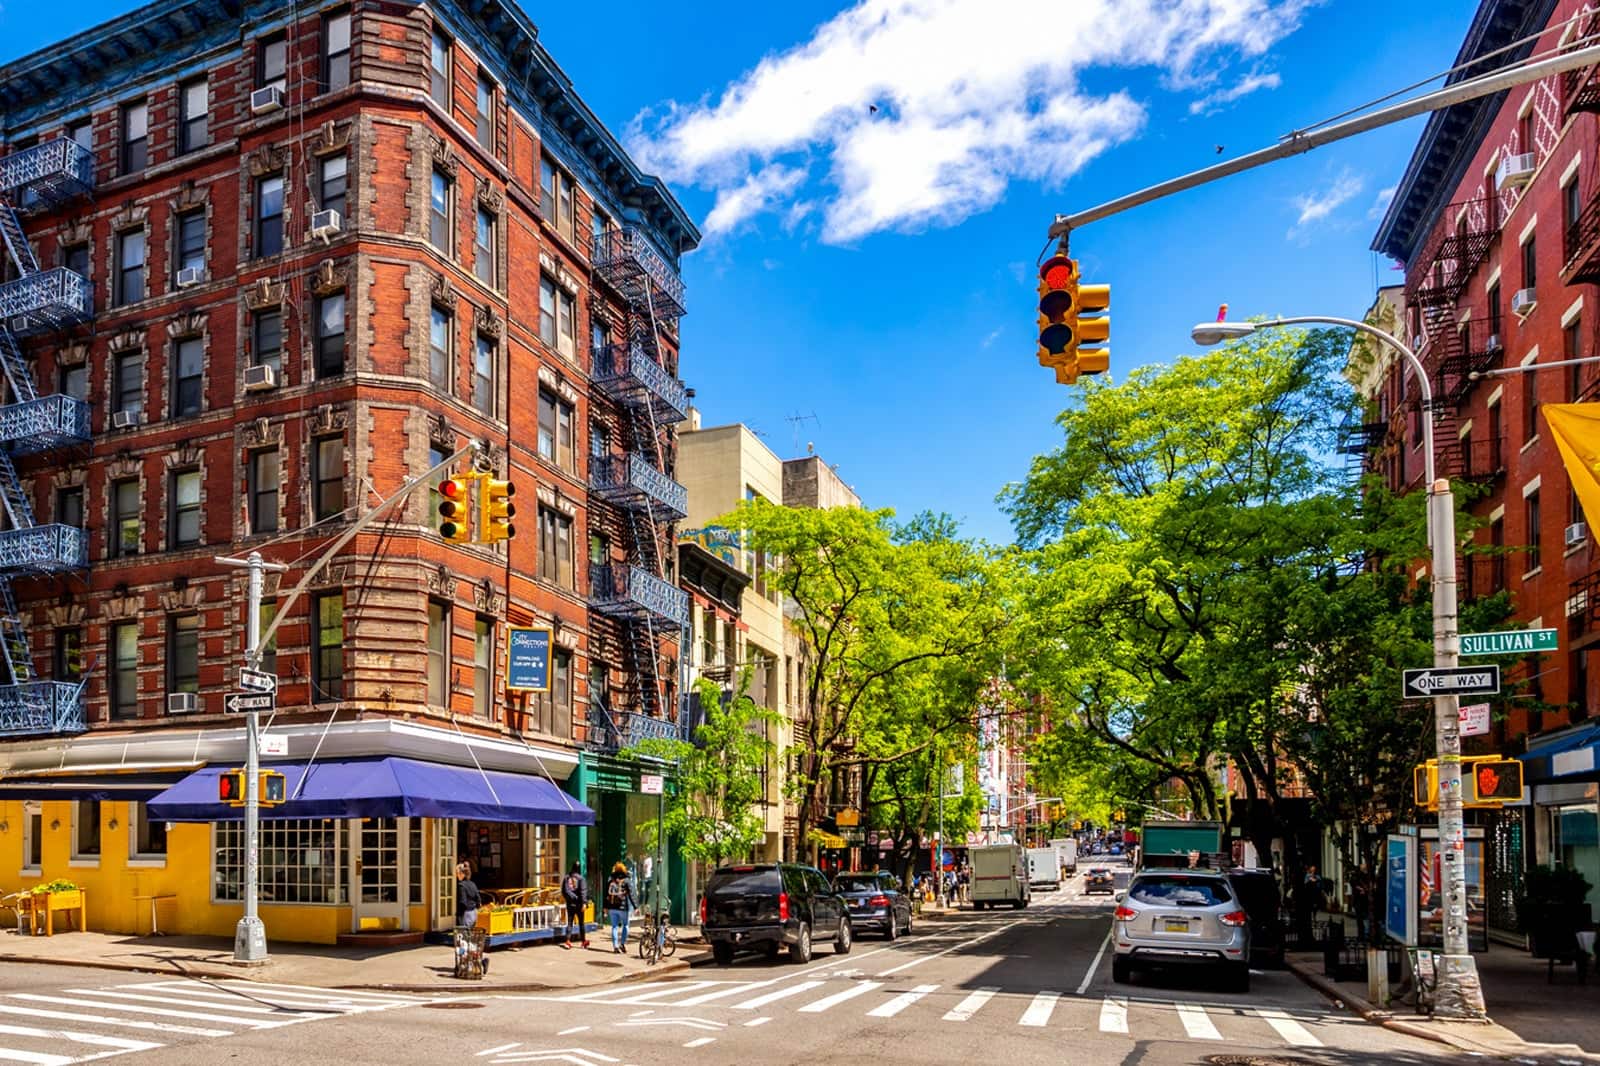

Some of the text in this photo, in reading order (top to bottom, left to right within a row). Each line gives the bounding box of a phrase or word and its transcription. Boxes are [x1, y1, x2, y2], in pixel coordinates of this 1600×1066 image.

[1463, 631, 1552, 653] SULLIVAN ST
[1418, 674, 1486, 689] ONE WAY
[252, 697, 267, 706] WAY
